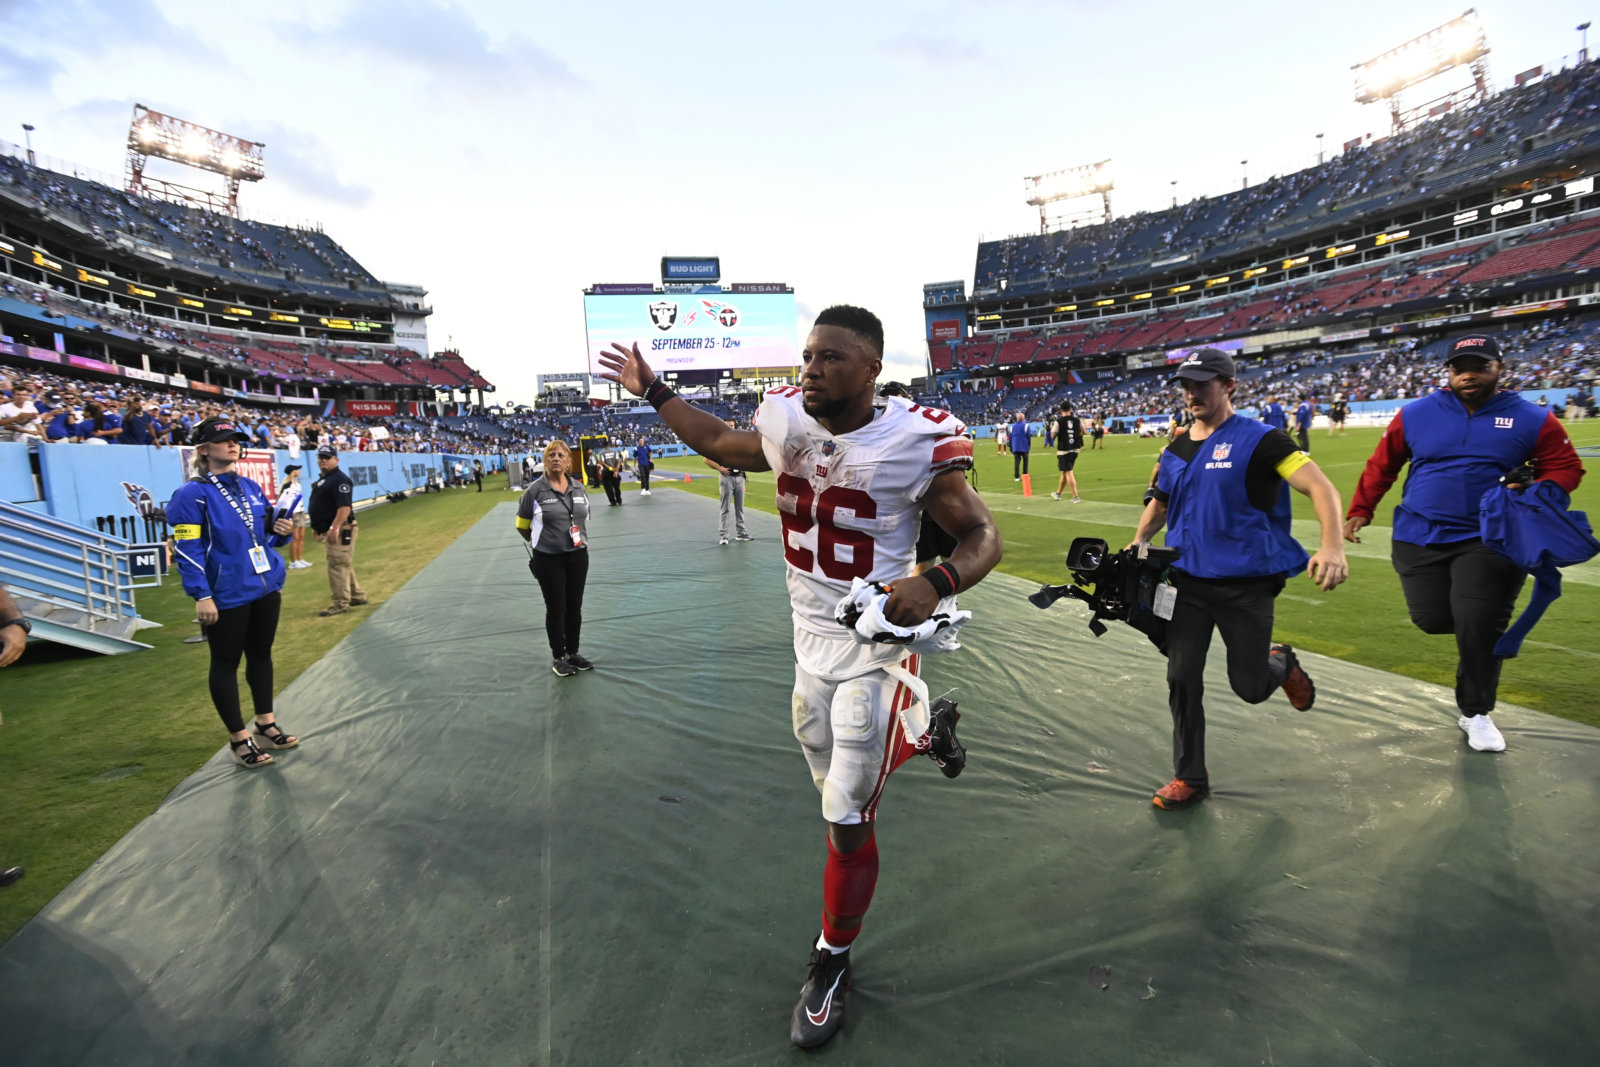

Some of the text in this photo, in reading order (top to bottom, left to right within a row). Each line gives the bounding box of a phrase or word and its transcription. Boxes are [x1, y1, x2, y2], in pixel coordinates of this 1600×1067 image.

[670, 265, 714, 273] BUD LIGHT
[652, 338, 702, 350] SEPTEMBER
[704, 338, 716, 349] 25
[722, 337, 741, 348] 12PM
[1018, 375, 1053, 383] NISSAN
[776, 471, 877, 581] 26
